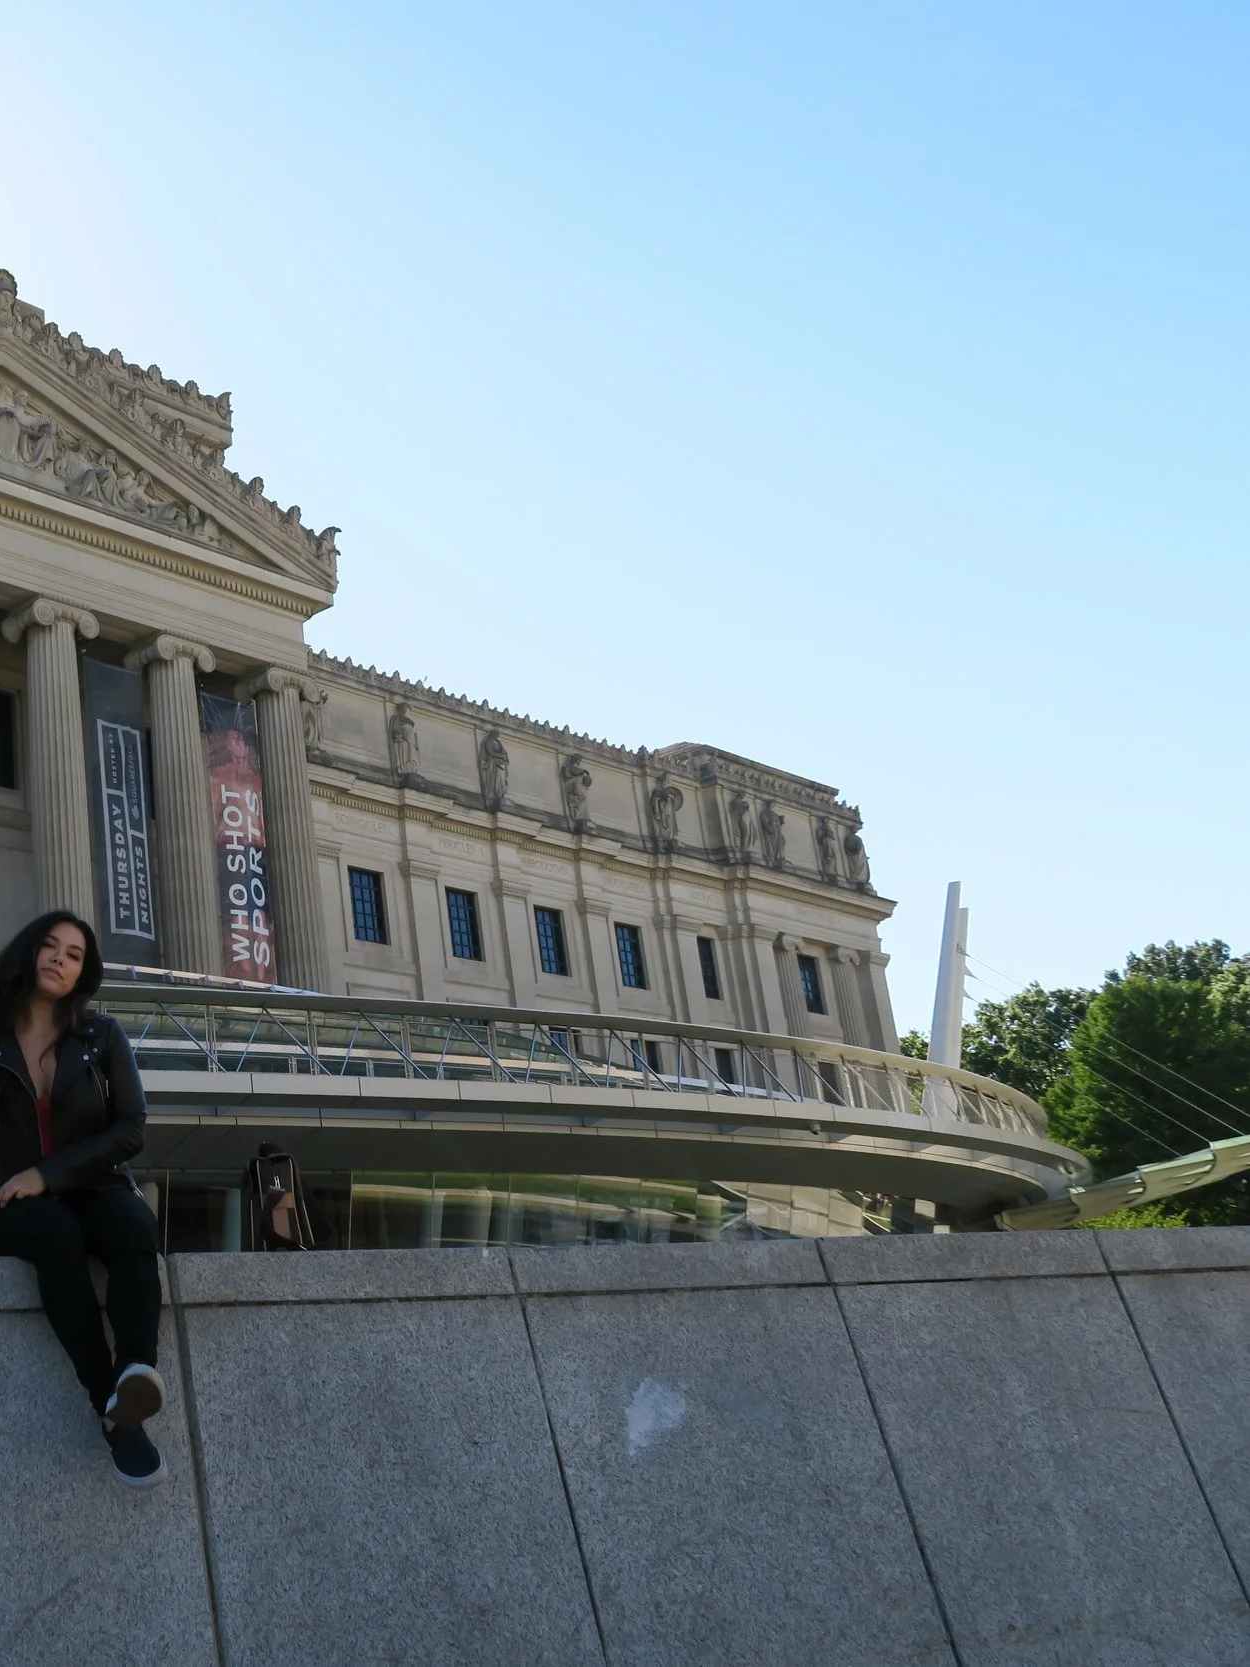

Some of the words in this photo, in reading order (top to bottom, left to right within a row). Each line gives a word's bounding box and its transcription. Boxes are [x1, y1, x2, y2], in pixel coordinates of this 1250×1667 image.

[112, 804, 130, 918] THURSDAY
[221, 784, 246, 873] SHOT
[135, 846, 148, 924] NIGHTS
[228, 884, 250, 961] WHO
[245, 790, 270, 967] SPORTS
